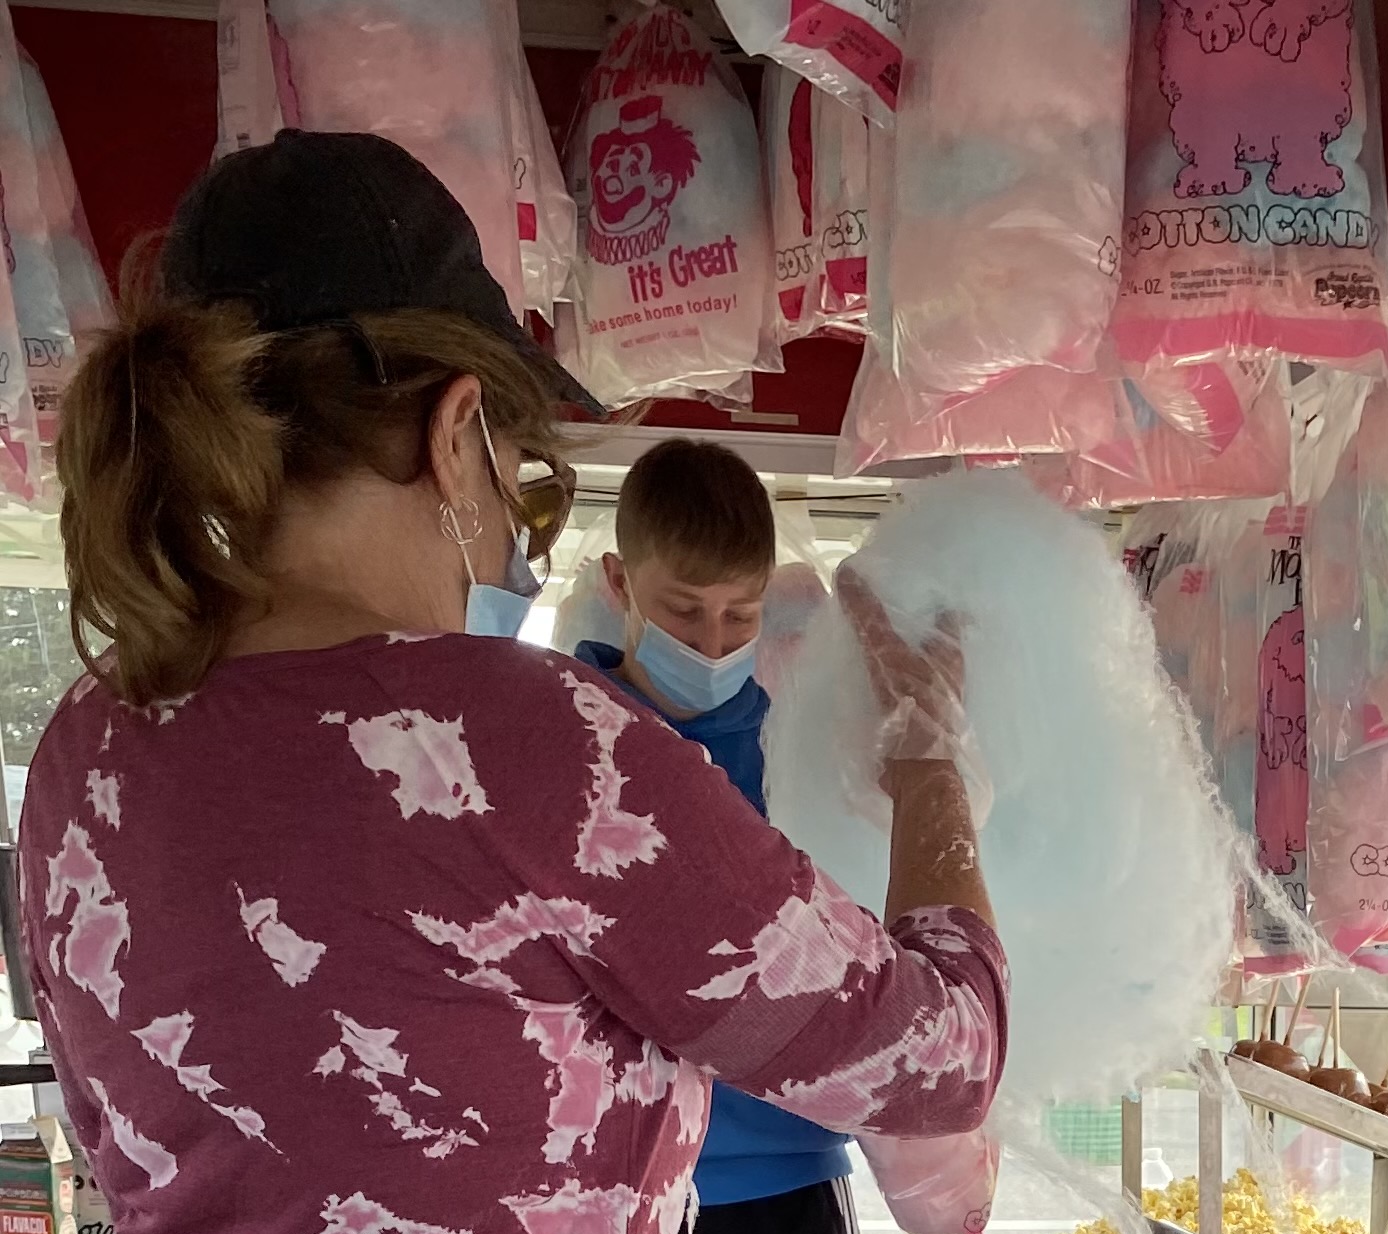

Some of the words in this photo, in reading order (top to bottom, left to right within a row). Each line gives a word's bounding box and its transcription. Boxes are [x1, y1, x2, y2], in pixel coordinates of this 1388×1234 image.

[627, 261, 664, 303] it's
[668, 234, 739, 288] Great
[588, 318, 607, 335] ake
[609, 310, 642, 330] some
[643, 303, 684, 322] home
[687, 293, 737, 315] today!
